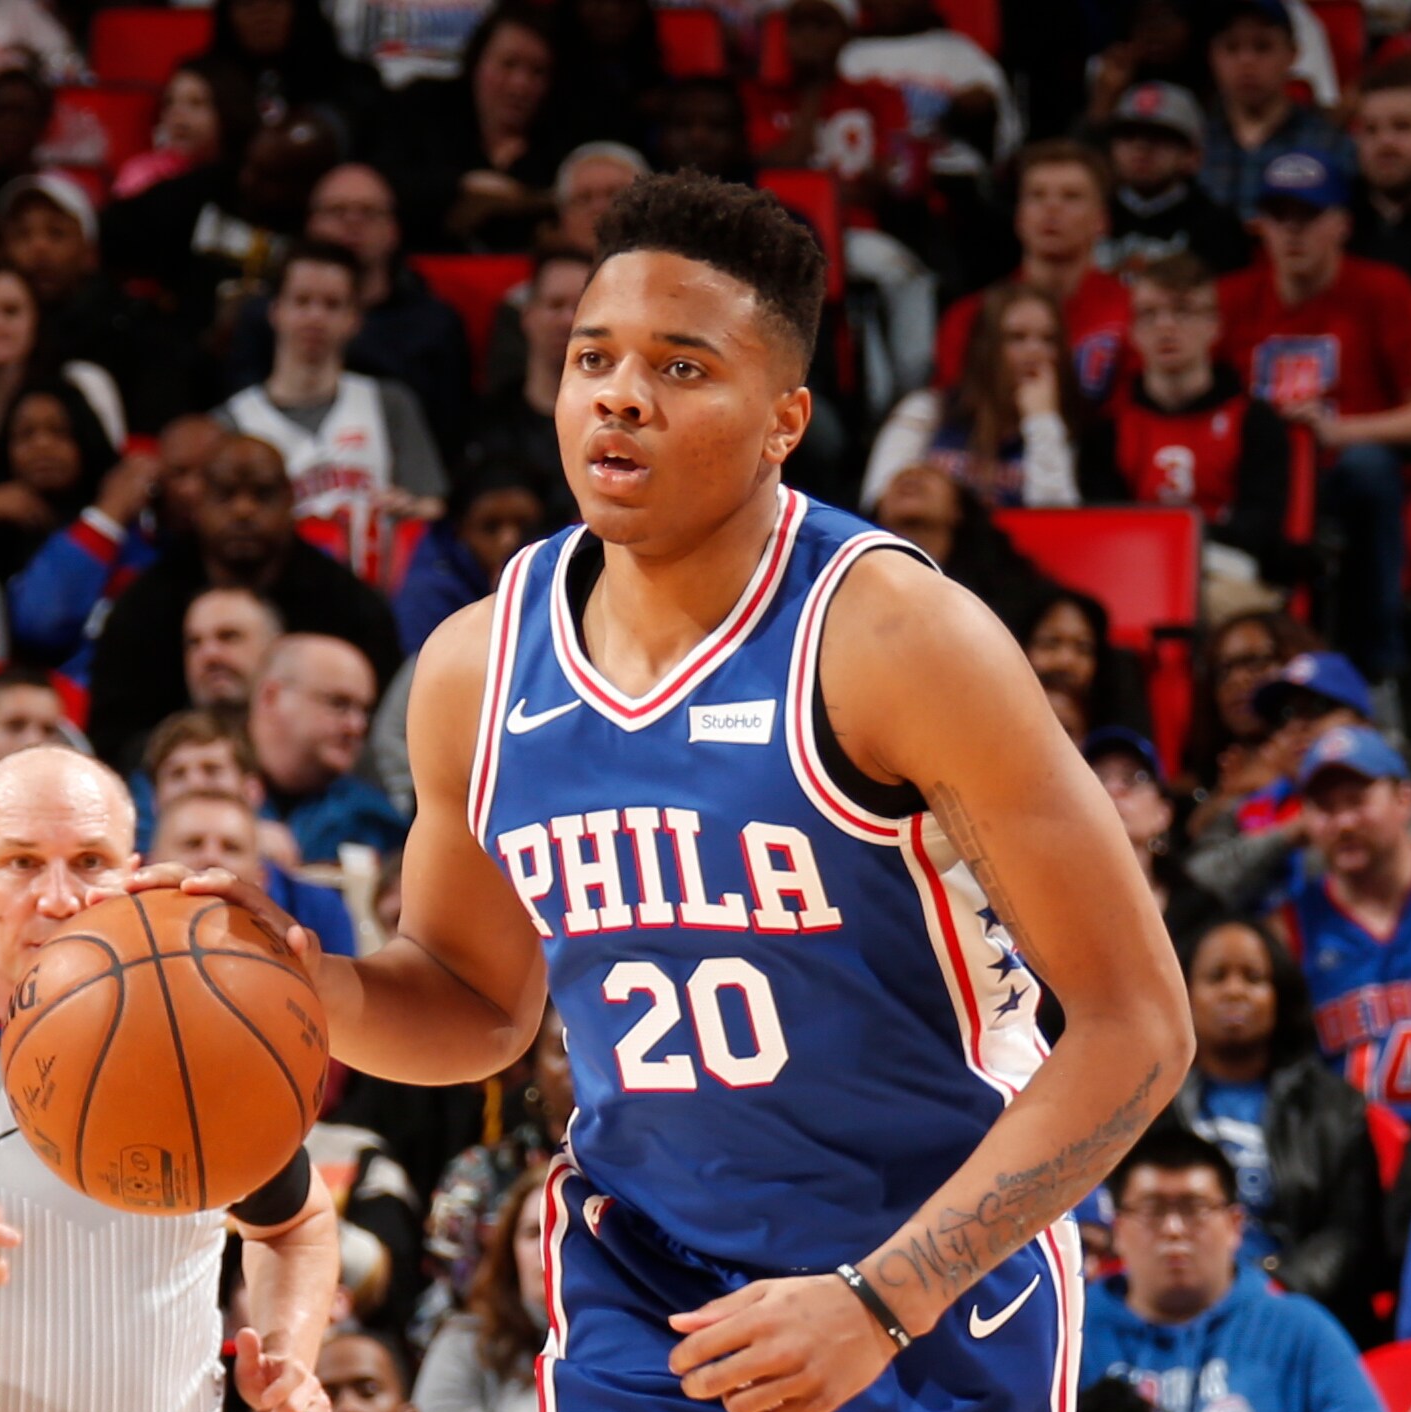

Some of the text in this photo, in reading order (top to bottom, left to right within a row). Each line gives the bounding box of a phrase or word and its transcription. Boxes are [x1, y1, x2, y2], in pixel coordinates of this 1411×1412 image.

[701, 713, 763, 730] StubHub
[496, 807, 844, 939] PHILA
[602, 956, 790, 1093] 20
